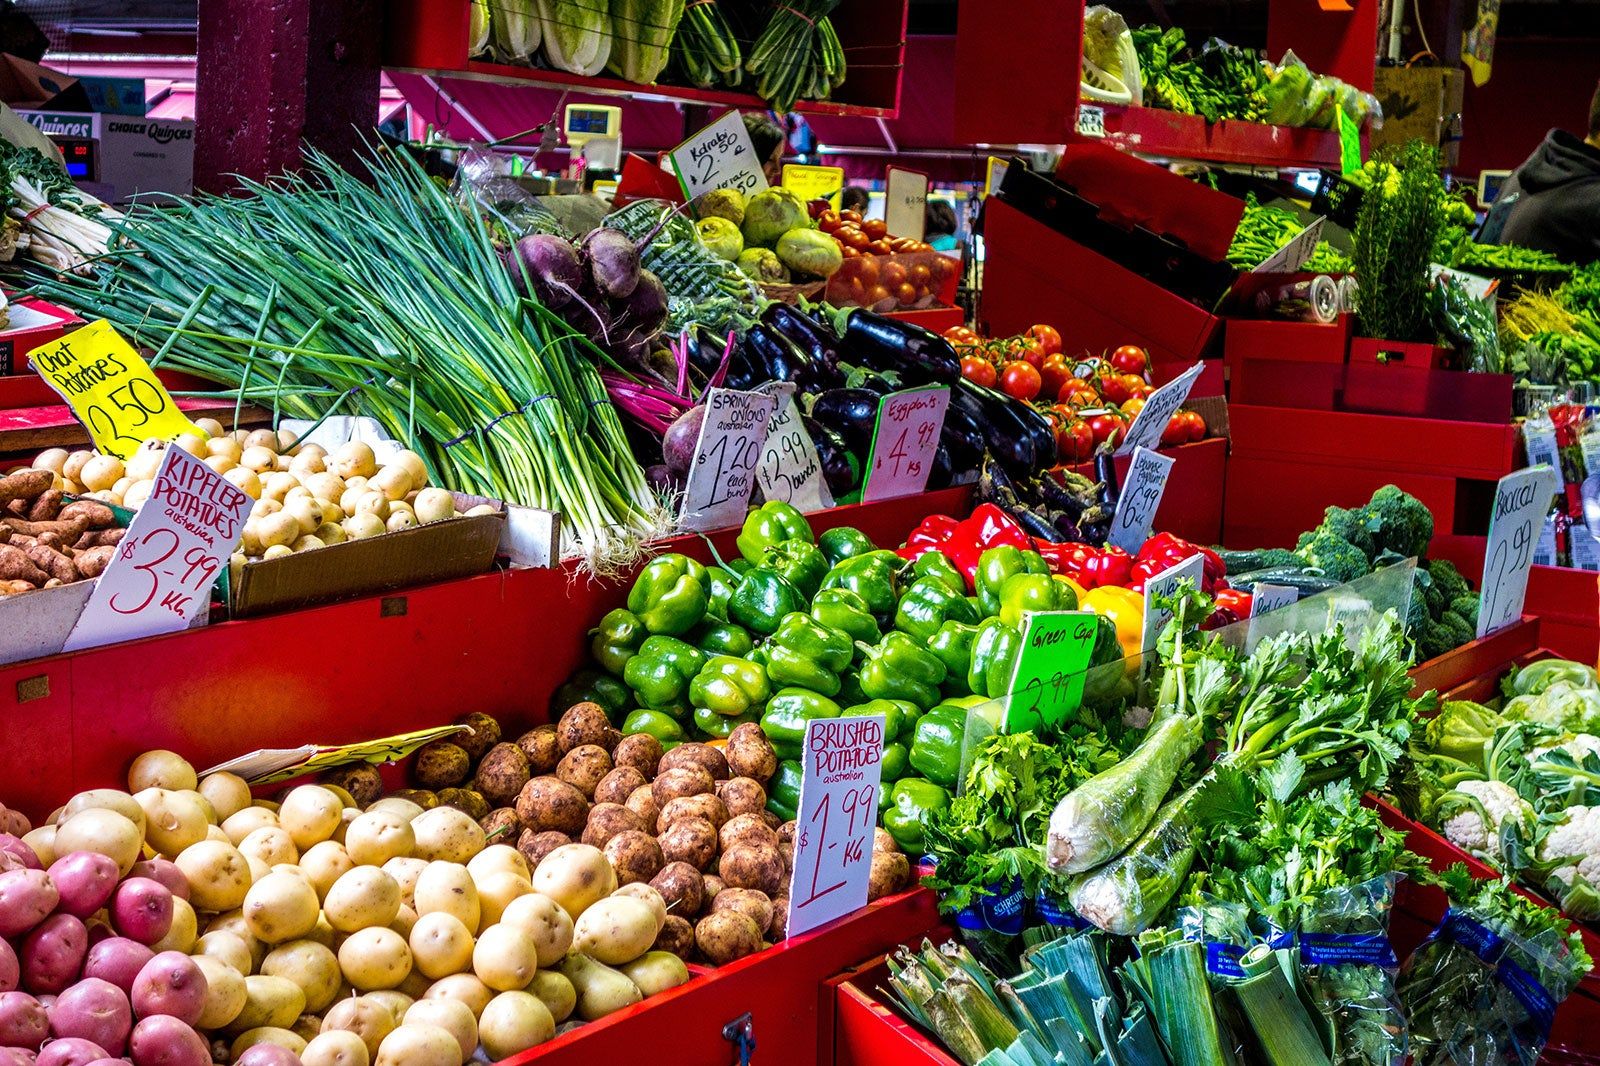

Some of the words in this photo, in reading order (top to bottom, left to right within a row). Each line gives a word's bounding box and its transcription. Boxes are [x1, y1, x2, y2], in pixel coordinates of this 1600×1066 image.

[108, 122, 147, 135] CHOICE
[148, 123, 192, 144] Quinces
[37, 342, 77, 373] Chat
[53, 353, 128, 396] Potatoes
[713, 394, 751, 409] SPRING
[730, 408, 765, 422] ONIONS
[165, 452, 246, 520] KIPFLER
[727, 472, 748, 487] each
[153, 477, 239, 539] POTATOES
[164, 508, 214, 548] australian
[1031, 625, 1067, 648] Green
[810, 719, 882, 753] BRUSHED
[815, 744, 882, 777] POTATOES
[823, 771, 865, 784] australian
